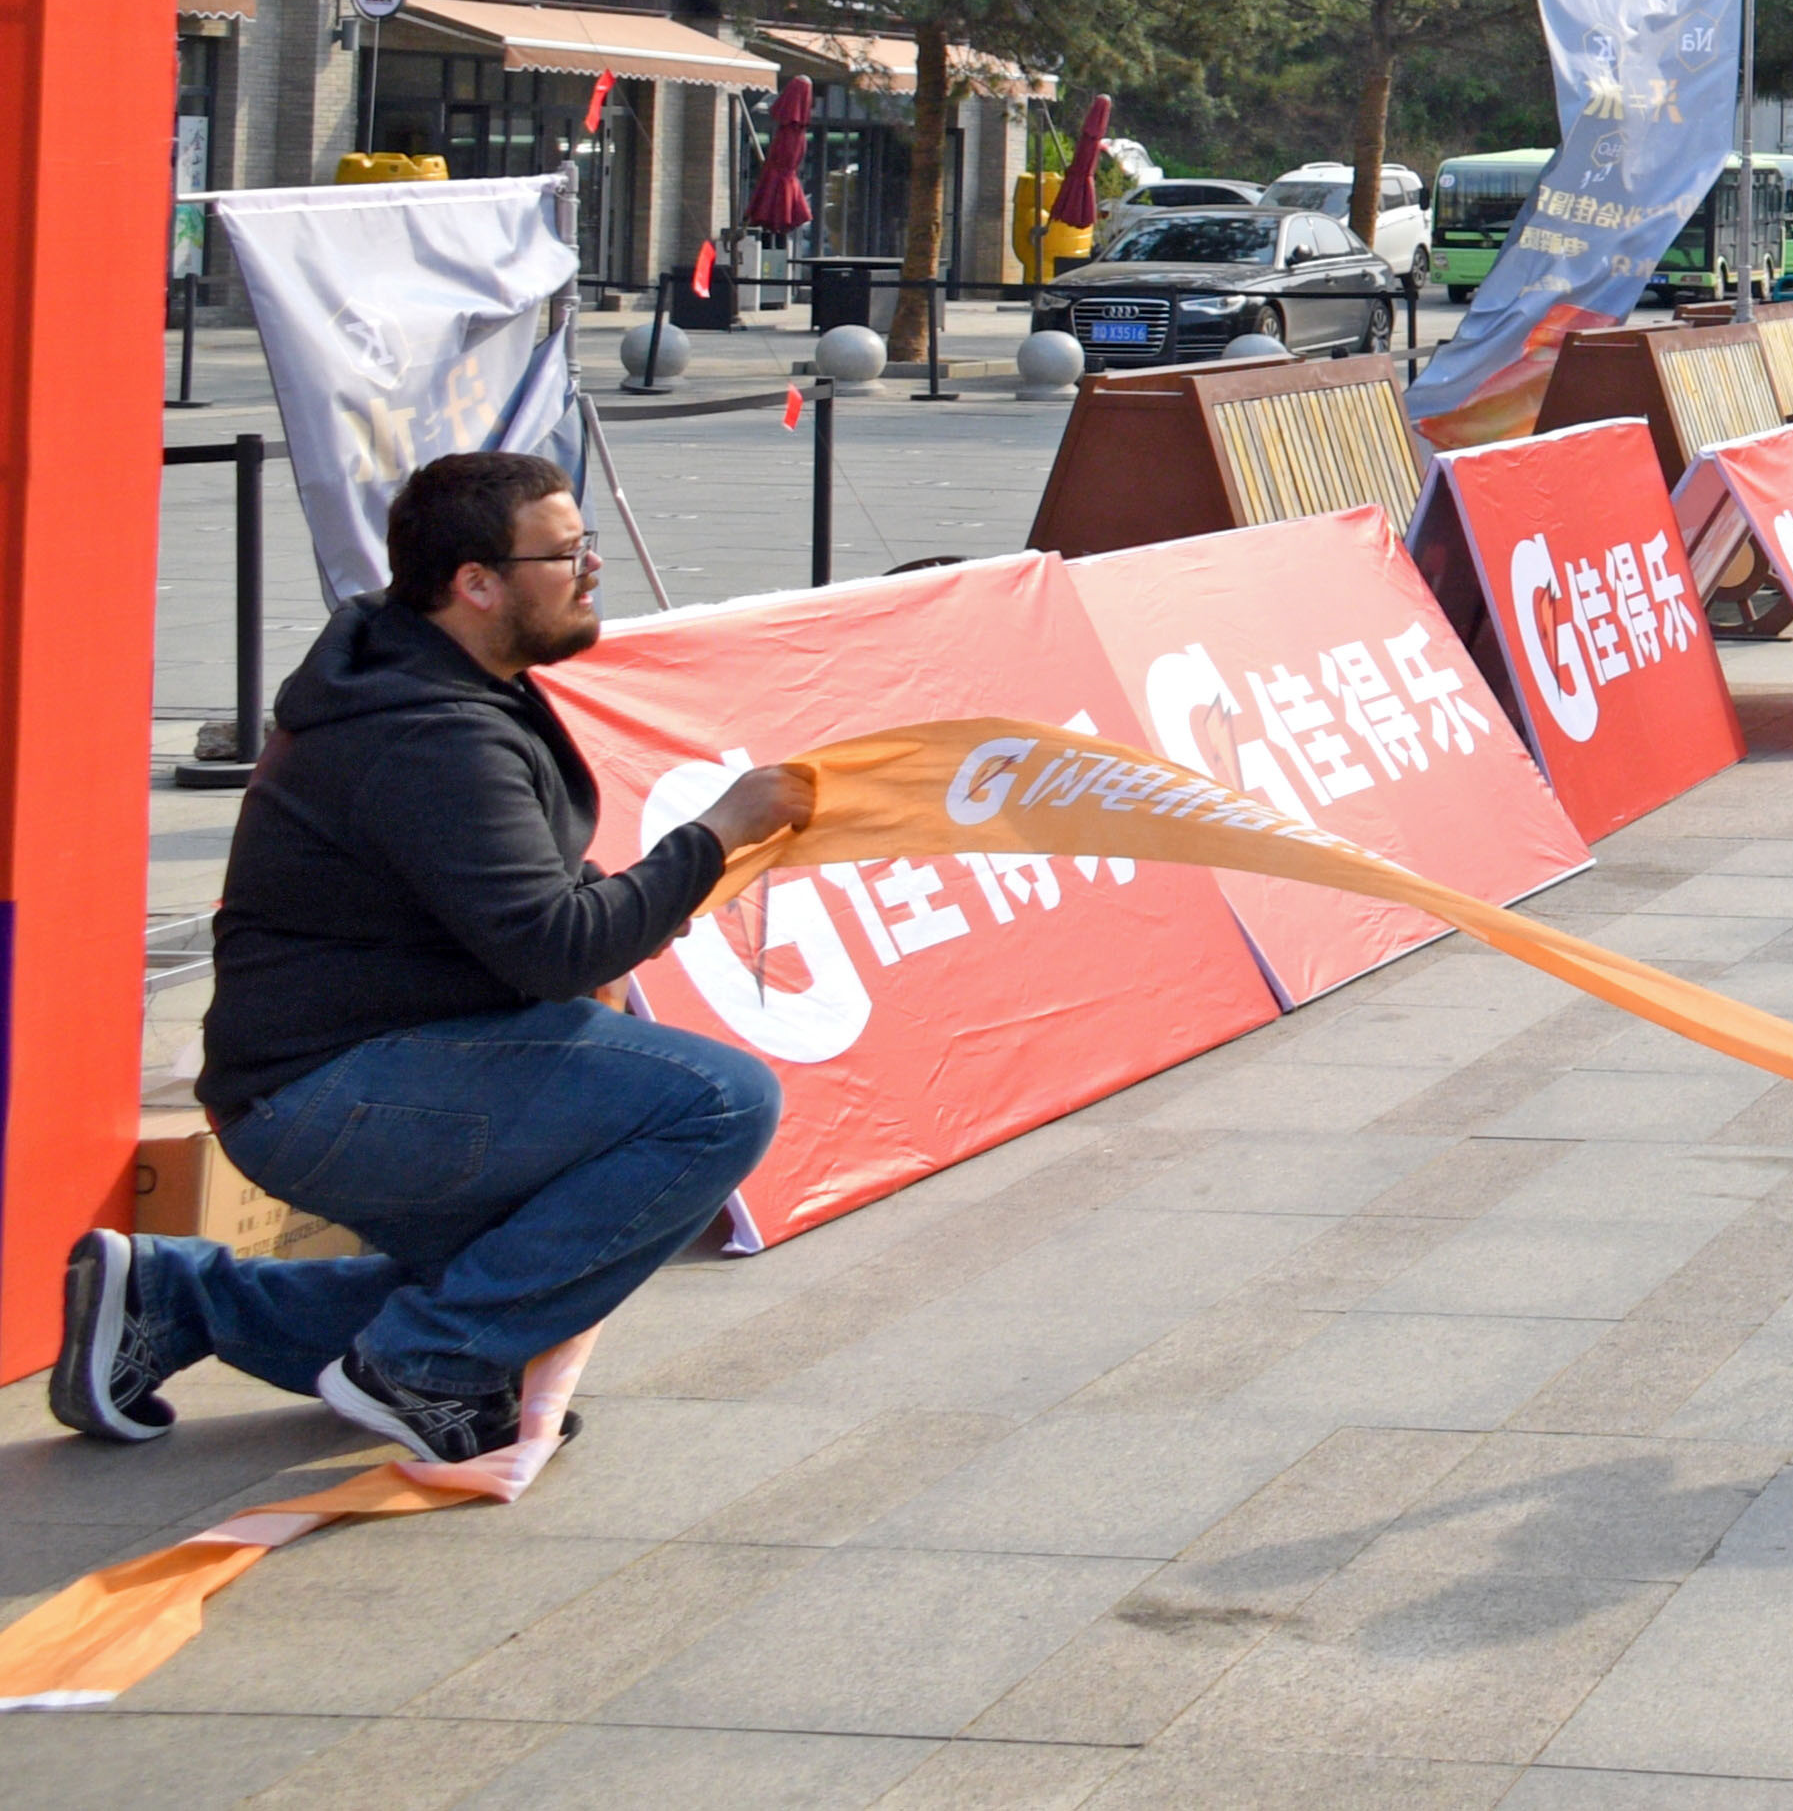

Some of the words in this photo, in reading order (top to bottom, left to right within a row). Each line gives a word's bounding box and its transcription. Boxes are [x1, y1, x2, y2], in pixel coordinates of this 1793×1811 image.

[1565, 529, 1697, 686] 佳得乐
[1242, 622, 1490, 806] 佳得乐
